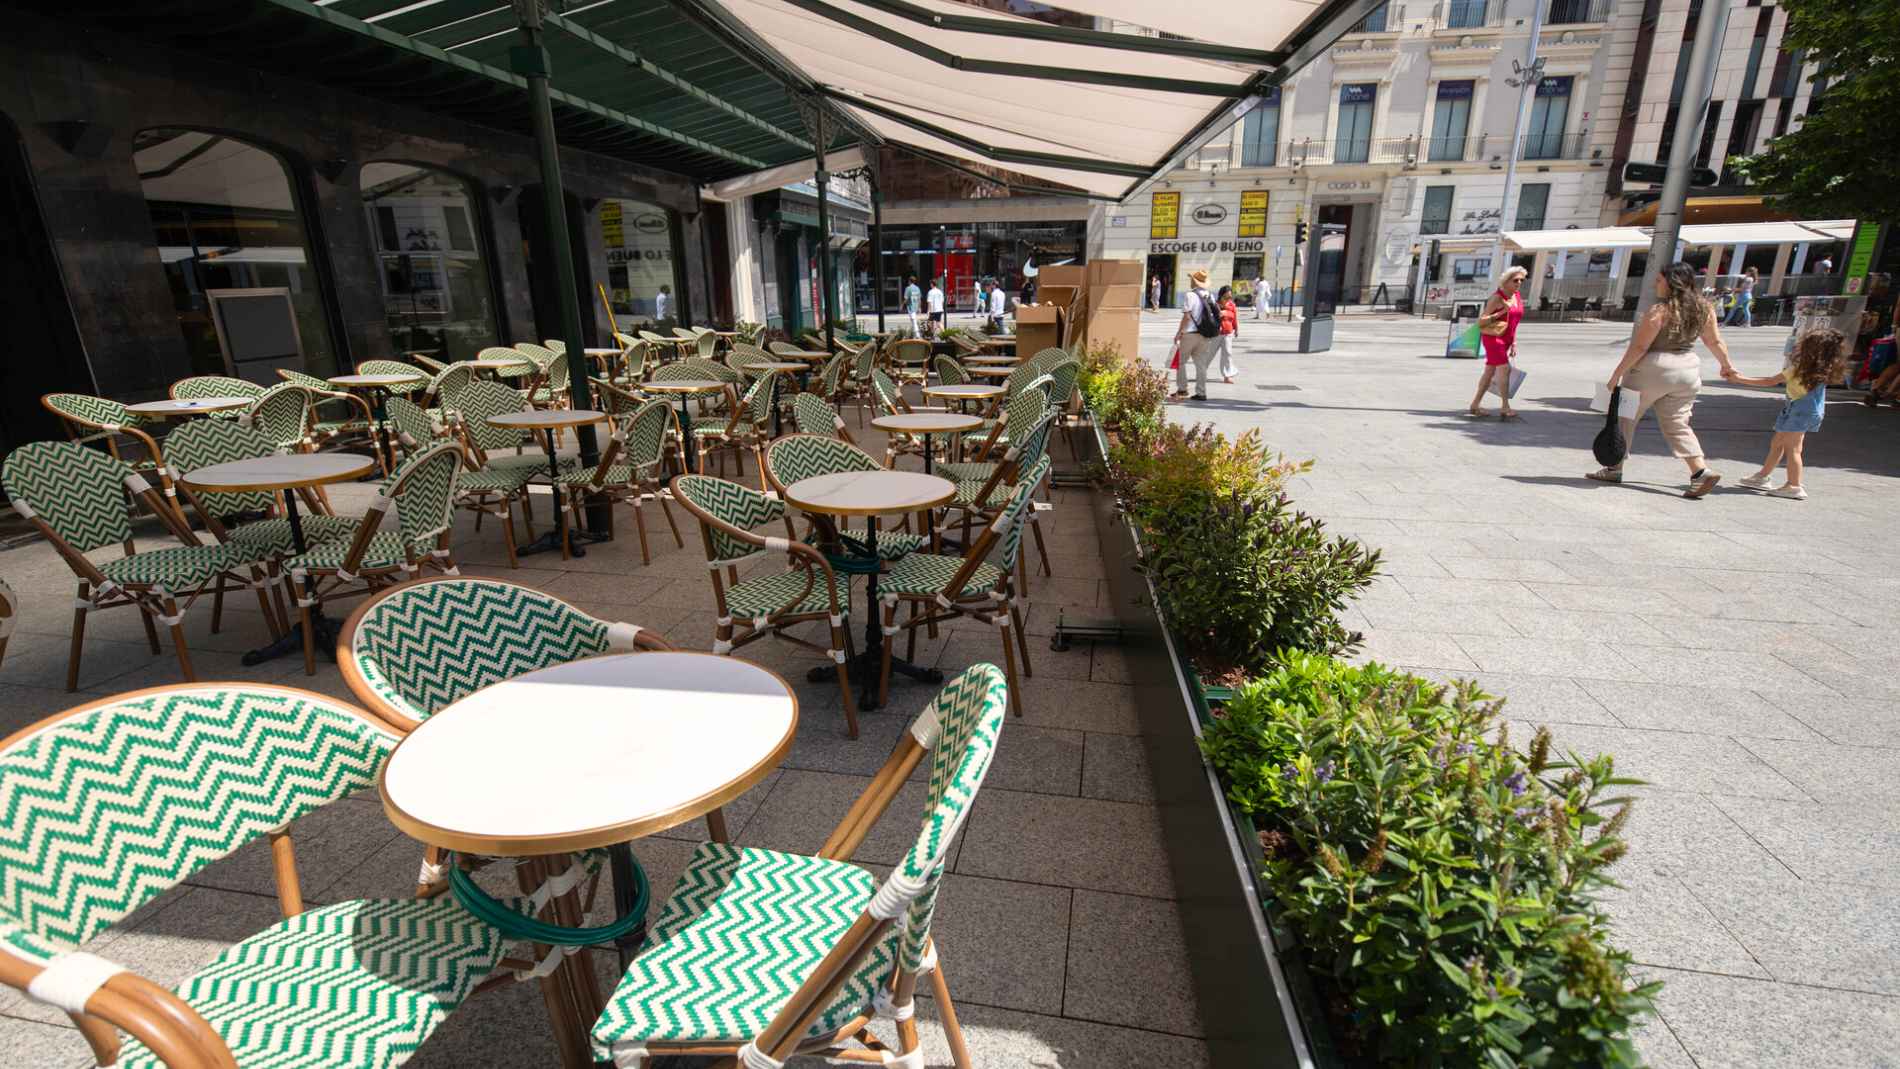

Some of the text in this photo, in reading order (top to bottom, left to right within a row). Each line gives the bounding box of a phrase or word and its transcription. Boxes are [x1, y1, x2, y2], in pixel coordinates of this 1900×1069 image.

[1151, 241, 1264, 253] ESCOGE LO BUENO
